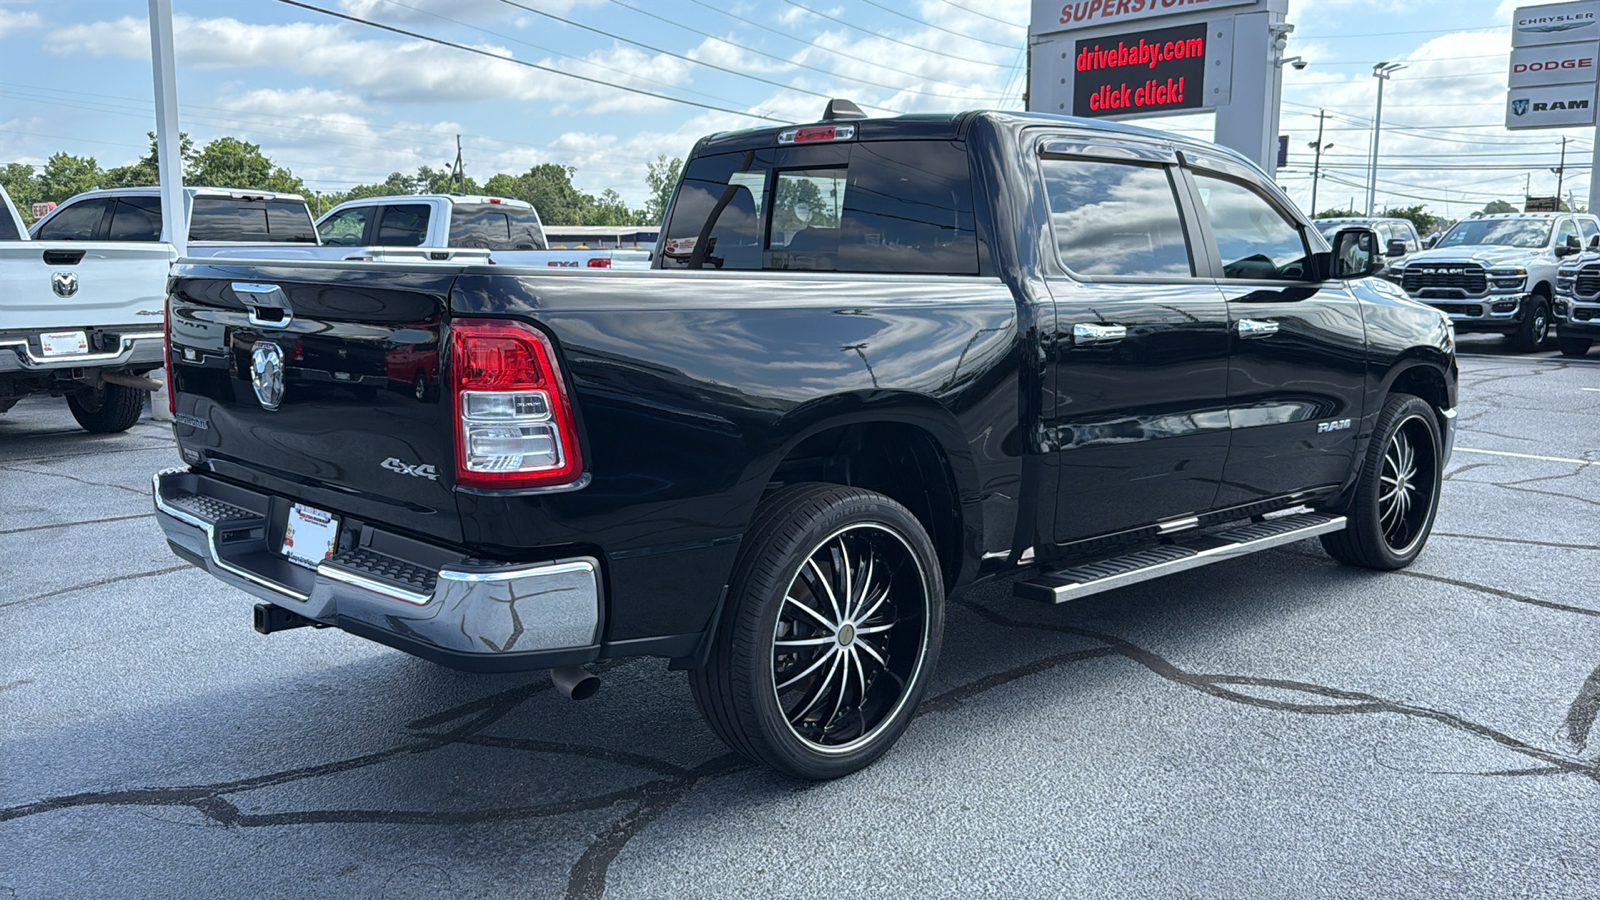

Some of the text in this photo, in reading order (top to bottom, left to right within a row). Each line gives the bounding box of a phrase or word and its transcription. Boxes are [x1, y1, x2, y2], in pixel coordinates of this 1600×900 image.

[1059, 0, 1208, 24] SUPERS
[1518, 12, 1594, 26] CHRYSLER
[1076, 37, 1203, 72] drivebaby.com
[1513, 57, 1593, 74] DODGE
[1089, 76, 1185, 111] click click!
[1532, 99, 1589, 112] RAM
[1422, 267, 1464, 276] RAM
[1317, 418, 1351, 434] RAM
